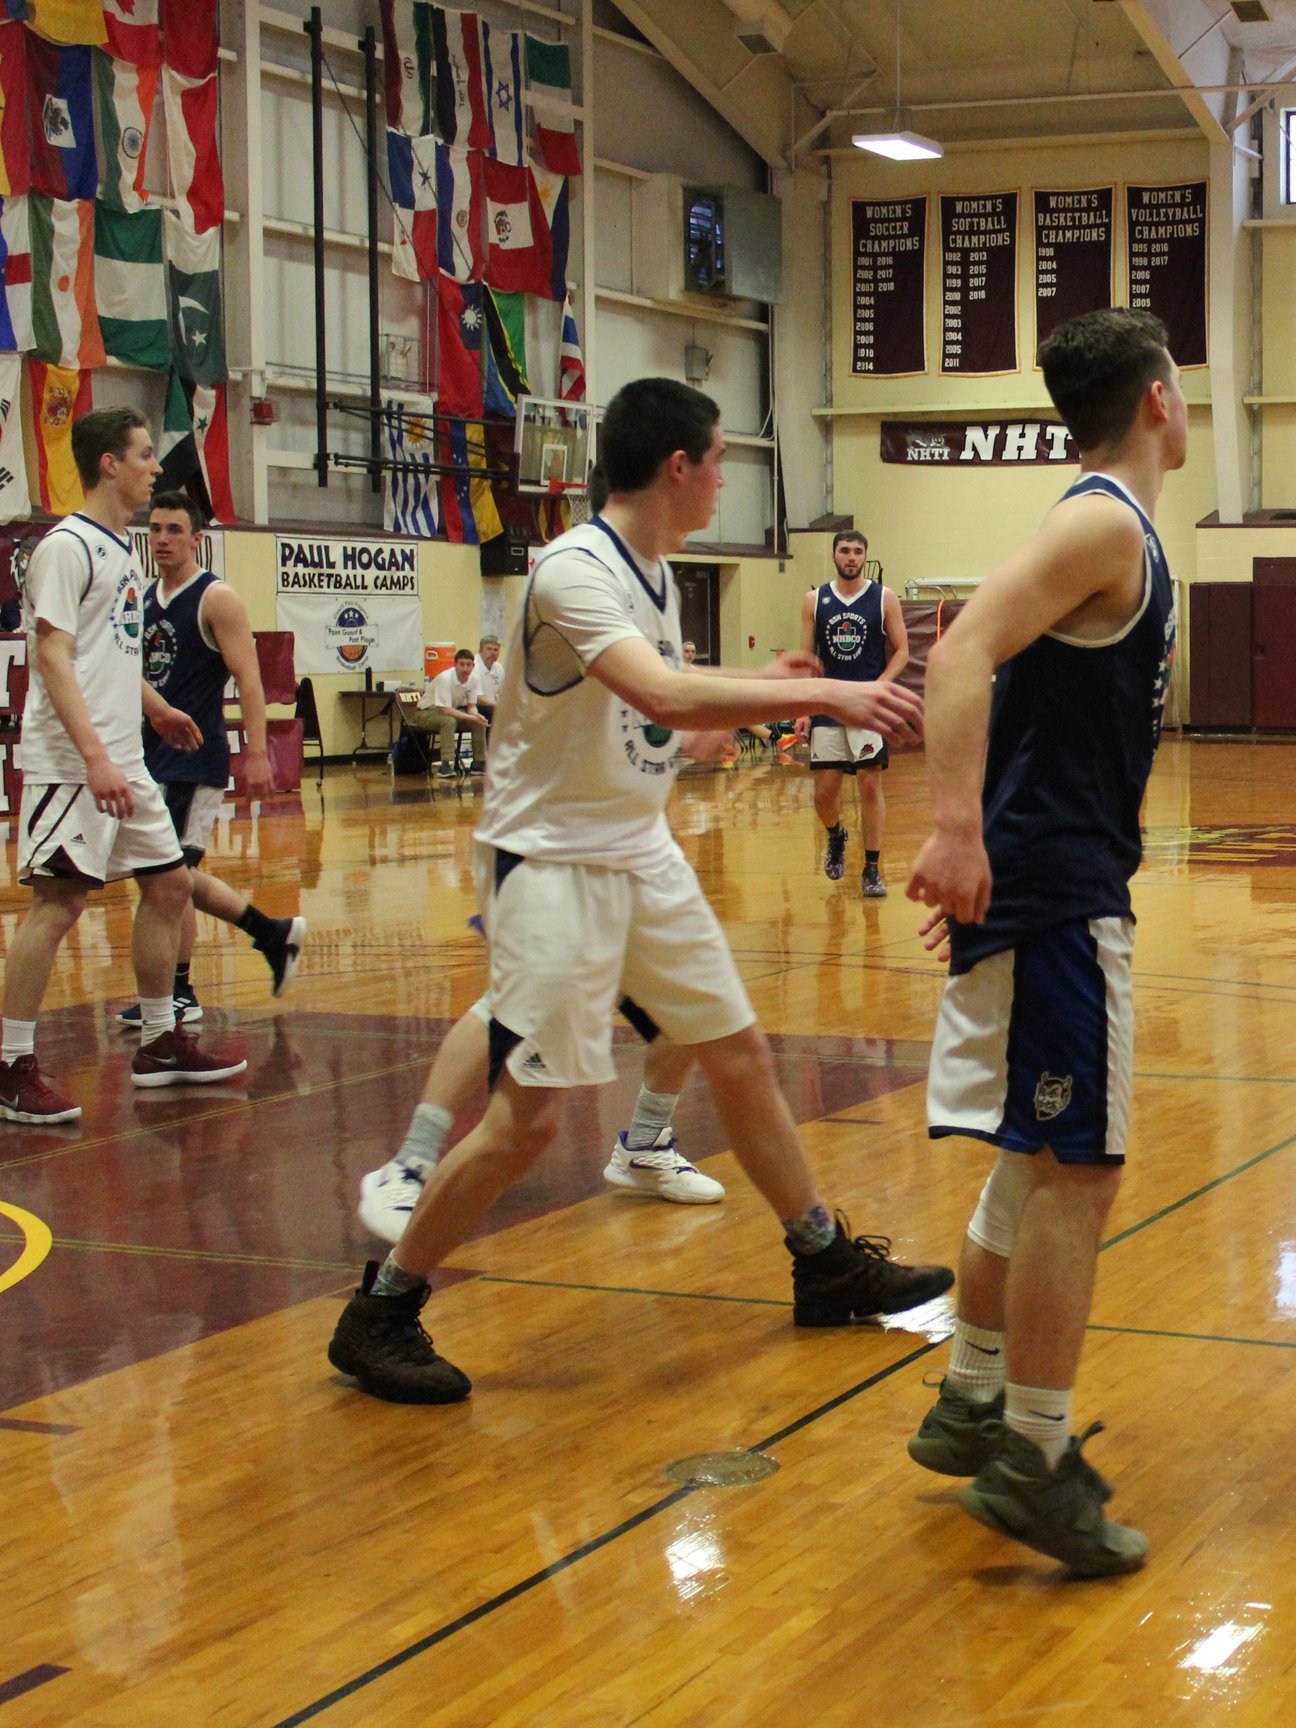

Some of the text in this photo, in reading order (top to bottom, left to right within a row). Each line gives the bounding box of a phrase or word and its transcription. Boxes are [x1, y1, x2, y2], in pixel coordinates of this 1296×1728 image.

[1049, 194, 1098, 208] WOMEN'S
[1142, 189, 1192, 204] WOMEN'S
[866, 204, 912, 218] WOMEN'S
[955, 199, 1002, 214] WOMEN'S
[1038, 210, 1109, 226] BASKETBALL
[1131, 205, 1203, 222] VOLLEYBALL
[870, 222, 909, 236] SOCCER
[952, 216, 1007, 231] SOFTBALL
[1042, 228, 1106, 243] CHAMPIONS
[1135, 222, 1200, 239] CHAMPIONS
[859, 236, 920, 252] CHAMPIONS
[949, 232, 1010, 248] CHAMPIONS
[970, 252, 987, 261] 2013
[1151, 256, 1168, 266] 2017
[969, 265, 986, 274] 2015
[1038, 261, 1056, 270] 2004
[877, 269, 893, 278] 2017
[1038, 274, 1056, 284] 2005
[969, 277, 986, 287] 2017
[1038, 288, 1056, 297] 2007
[1132, 284, 1150, 294] 2007
[857, 296, 874, 305] 2004
[856, 309, 874, 318] 2005
[944, 305, 961, 314] 2002
[945, 332, 962, 341] 2004
[945, 345, 962, 354] 2005
[856, 362, 874, 370] 2014
[944, 358, 960, 367] 2011
[959, 424, 1077, 460] NHT
[906, 448, 950, 460] NHTI
[280, 542, 415, 572] PAUL HOGAN
[281, 571, 414, 590] BASKETBALL CAMPS
[842, 612, 866, 625] SPORTS
